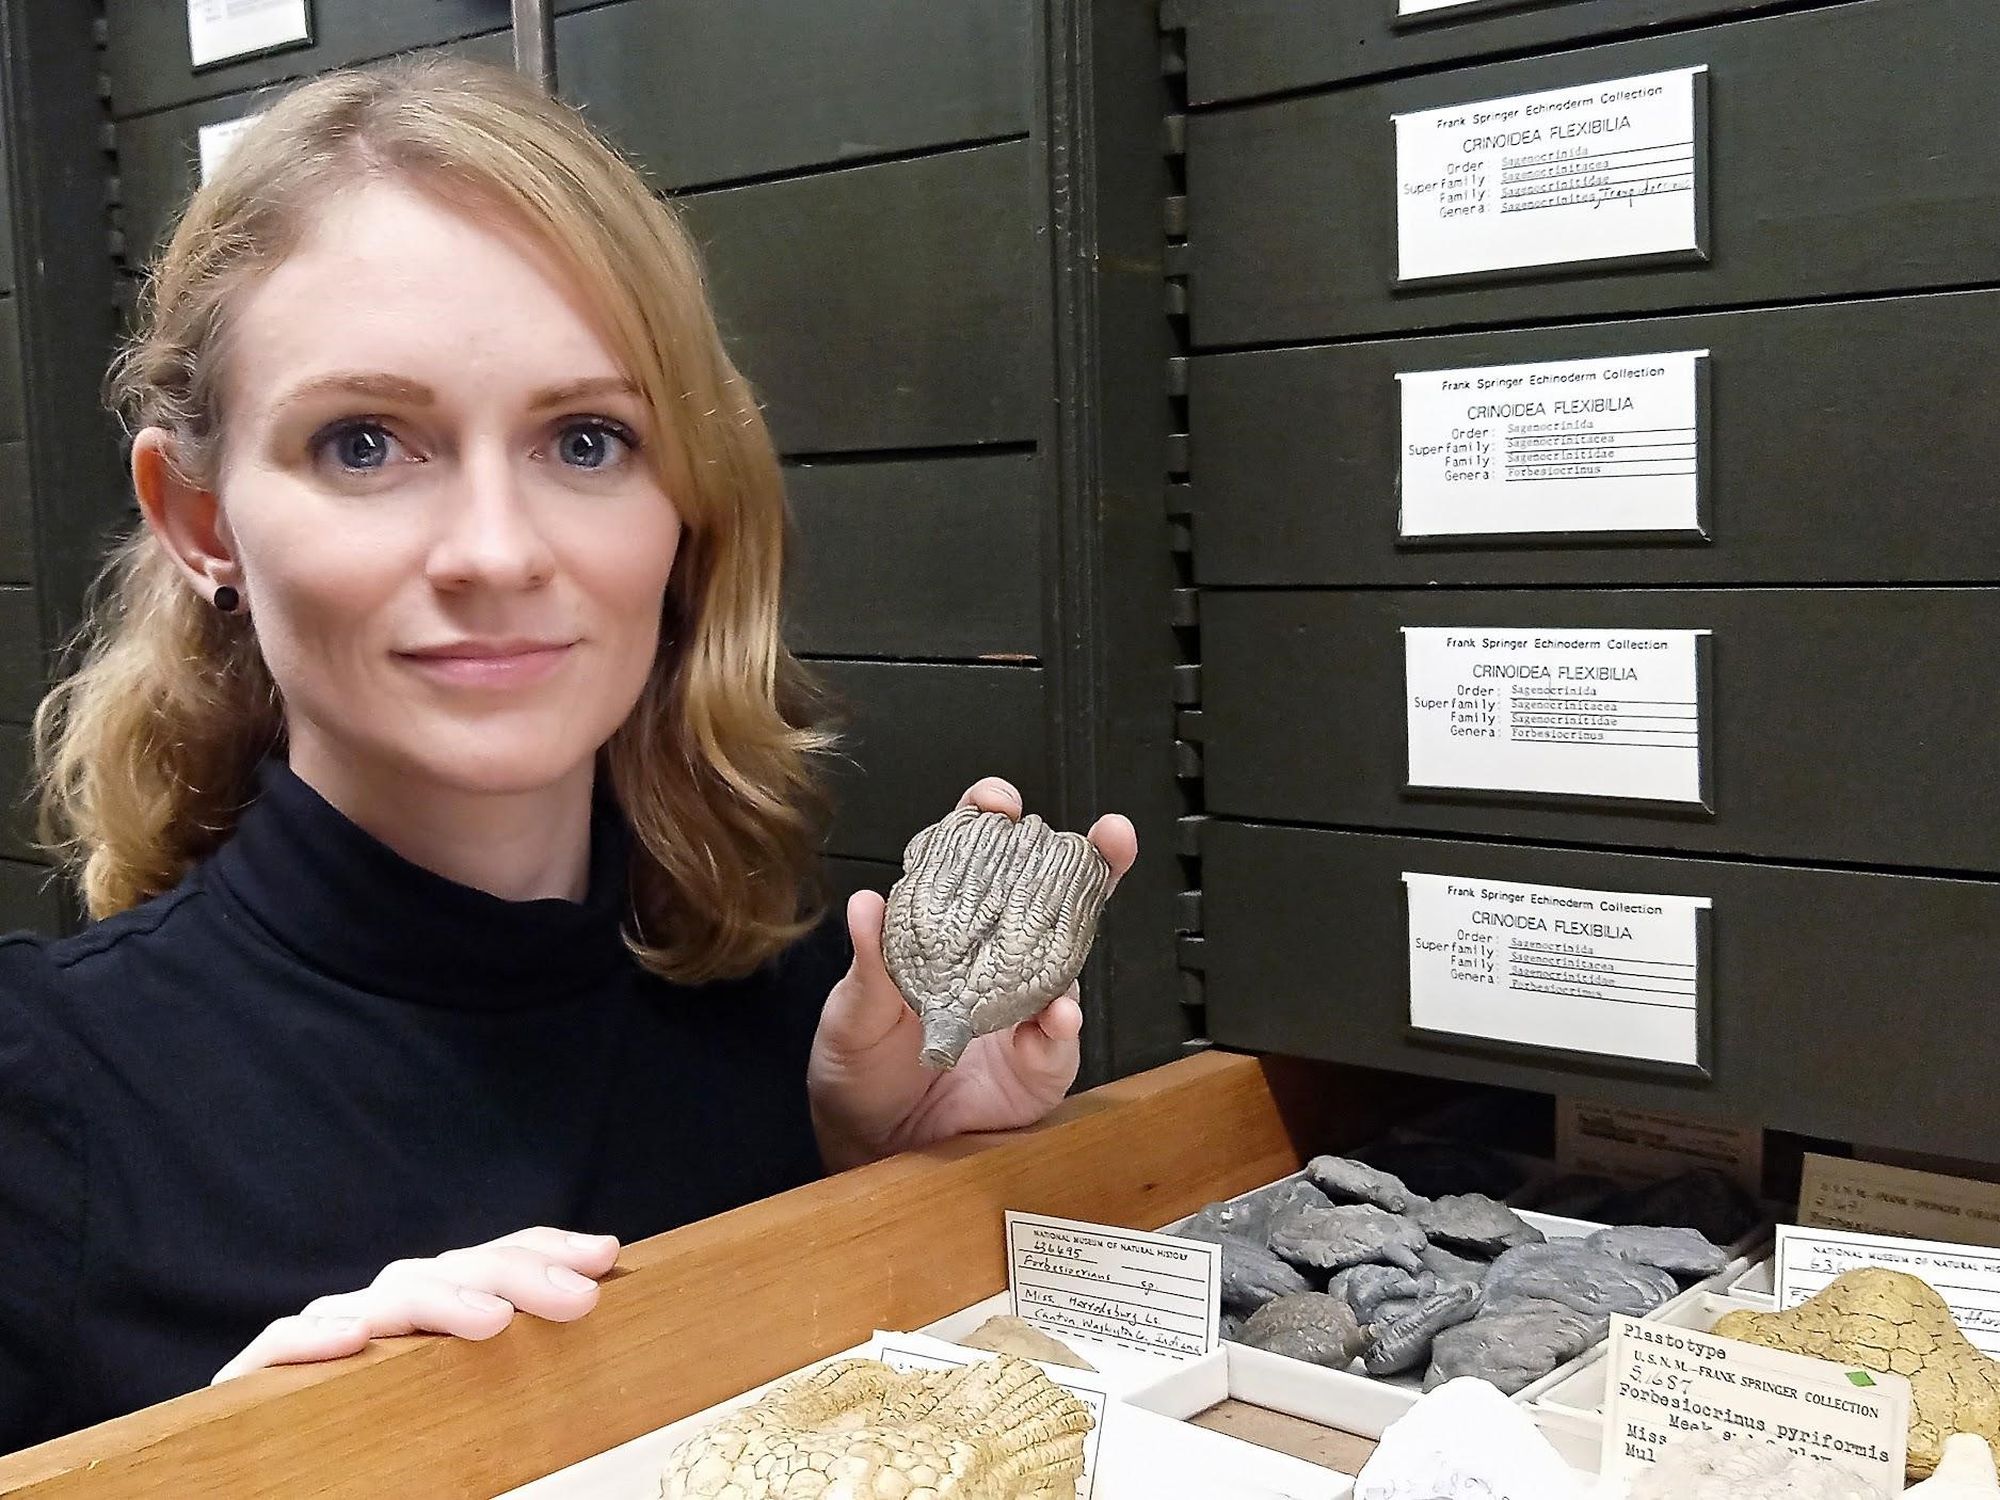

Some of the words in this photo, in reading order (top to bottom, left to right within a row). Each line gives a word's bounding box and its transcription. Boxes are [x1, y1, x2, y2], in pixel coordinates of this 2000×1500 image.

[1437, 117, 1466, 129] Frank
[1472, 109, 1519, 125] Springer
[1526, 98, 1593, 116] Echinoderm
[1600, 86, 1662, 104] Collection
[1462, 129, 1541, 153] CRINOIDEA
[1549, 116, 1630, 140] FLEXIBILIA
[1442, 380, 1470, 391] Frank
[1477, 377, 1523, 391] Springer
[1529, 372, 1596, 386] Echinoderm
[1603, 366, 1665, 380] Collection
[1467, 401, 1546, 420] CRINOIDEA
[1554, 397, 1634, 415] FLEXIBILIA
[1447, 637, 1475, 648] Frank
[1482, 638, 1527, 650] Springer
[1535, 638, 1600, 649] Echinoderm
[1607, 639, 1668, 650] Collection
[1473, 664, 1550, 679] CRINOIDEA
[1558, 666, 1638, 681] FLEXIBILIA
[1447, 885, 1475, 898] Frank
[1481, 889, 1525, 903] Springer
[1531, 894, 1593, 909] Echinoderm
[1600, 901, 1662, 915] Collection
[1472, 910, 1547, 932] CRINOIDEA
[1554, 920, 1633, 940] FLEXIBILIA
[1033, 1229, 1071, 1243] NATIONAL
[1073, 1236, 1103, 1248] MUSEUM
[1106, 1241, 1119, 1250] OF
[1120, 1243, 1153, 1257] NATURAL
[1156, 1249, 1190, 1261] HISTORY
[1623, 1323, 1727, 1361] Plastotype
[1740, 1376, 1798, 1400] SPRINGER
[1804, 1391, 1879, 1419] COLLECTION
[1775, 1422, 1890, 1463] pyriformis
